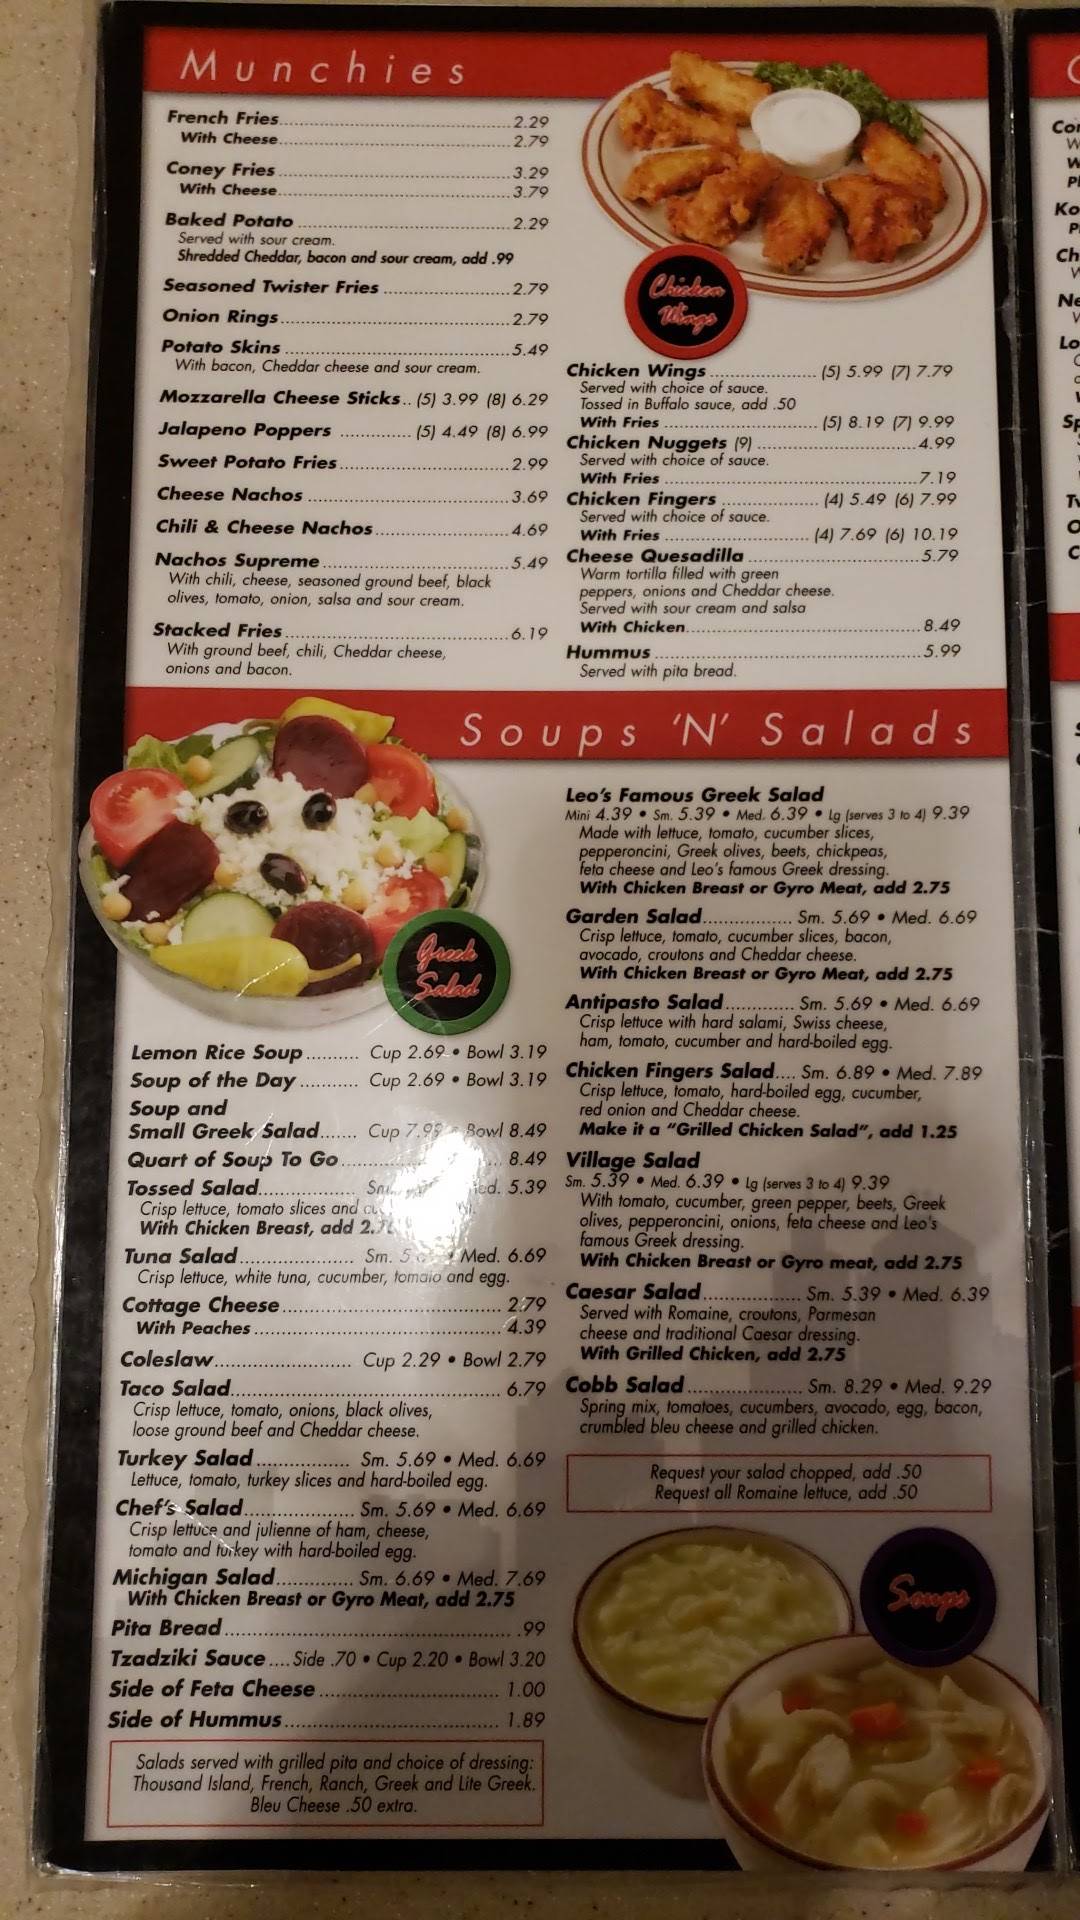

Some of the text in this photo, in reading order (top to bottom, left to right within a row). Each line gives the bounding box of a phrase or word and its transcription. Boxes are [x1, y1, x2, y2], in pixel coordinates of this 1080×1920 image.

[180, 49, 464, 84] Munchies
[167, 109, 550, 129] French Fries 2.29
[165, 211, 550, 231] Baked Potato 2.29
[177, 231, 335, 246] Served with sour cream.
[177, 247, 515, 266] Shredded Cheddar, bacon and sour cream, add .99
[162, 277, 549, 296] Seasoned Twister Fries 2.79
[649, 273, 726, 299] Chicken
[162, 308, 549, 328] Onion Rings 2.79
[658, 302, 718, 336] Wings
[566, 362, 953, 382] Chicken Wings (5) 5.99 (7) 7.79
[159, 388, 549, 409] Mozzarella Cheese Sticks (5) 3.99 (8) 6.29
[580, 396, 797, 412] Tossed in Buffalo sauce, add .50
[566, 434, 956, 454] Chicken Nuggets (9) 4.99
[157, 453, 549, 471] Sweet Potato Fries 2.99
[580, 471, 957, 485] With Fries 7.19
[154, 551, 549, 572] Nachos Supreme 5.49
[566, 547, 959, 564] Cheese Quesadilla 5.79
[169, 570, 491, 591] With chili, cheese, seasoned ground beef, black
[580, 565, 779, 584] Warm tortilla filled with green
[152, 621, 549, 641] Stacked Fries 6.19
[566, 643, 962, 660] Hummus 5.99
[165, 660, 292, 676] onions and bacon.
[460, 709, 971, 757] Soups 'N' Salads
[565, 785, 825, 803] Leo's Famous Greek Salad
[565, 907, 978, 925] Garden Salad Sm. 5.69 Med. 6.69
[417, 932, 478, 973] Greek
[415, 971, 482, 1001] Salad
[131, 1043, 548, 1065] Lemon Rice Soup Cup 2.69 Bowl 3.19
[127, 1149, 547, 1172] Quart of Soup To Go 8.49
[566, 1150, 701, 1174] Village Salad
[565, 1281, 990, 1302] Caesar Salad Sm. 5.39 Med. 6.39
[122, 1295, 547, 1318] Cottage Cheese 2.79
[120, 1349, 547, 1373] Coleslaw Cup 2.29 Bowl 2.79
[650, 1462, 922, 1485] Request your salad chopped, add .50
[112, 1566, 546, 1590] Michigan Salad Sm. 6.69 Med. 7.69
[887, 1573, 970, 1623] Soups
[135, 1751, 534, 1775] Salads served with grilled pita and choice of dressing:
